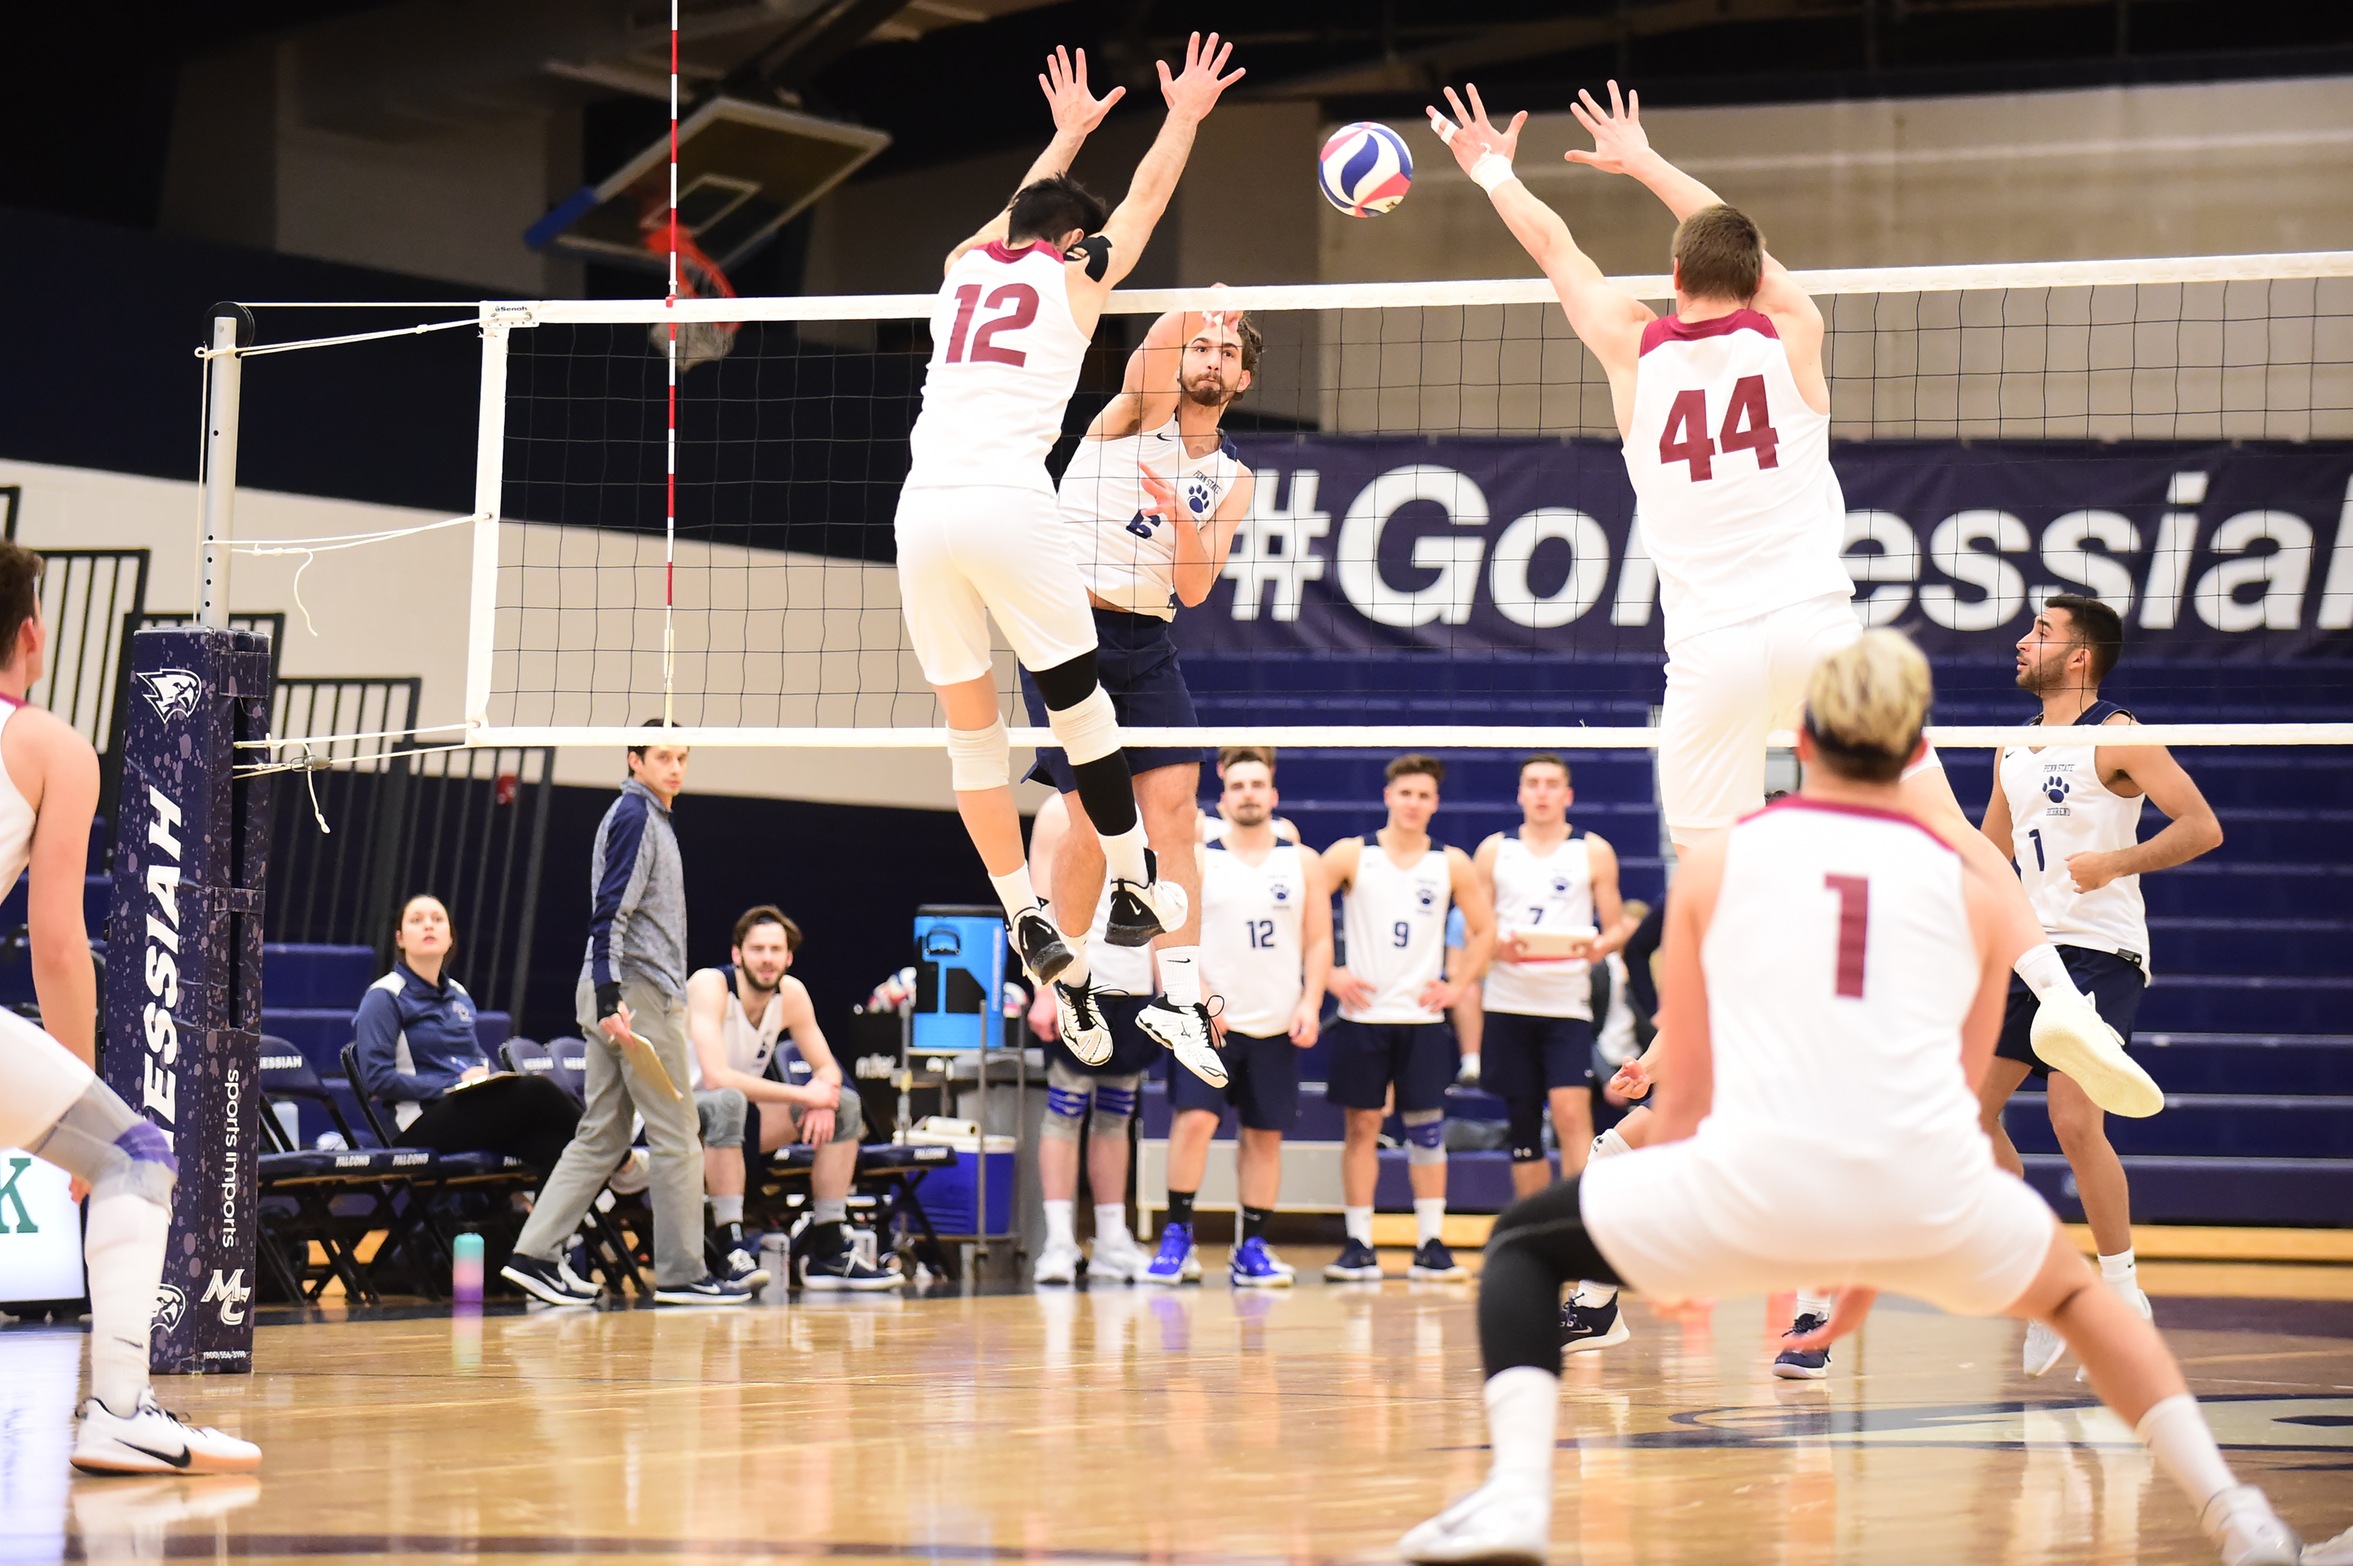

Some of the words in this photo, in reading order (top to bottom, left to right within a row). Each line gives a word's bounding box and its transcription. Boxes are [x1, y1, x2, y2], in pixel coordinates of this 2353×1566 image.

[945, 283, 1040, 368] 12
[1659, 374, 1780, 482] 44
[2028, 828, 2045, 872] 1
[1246, 920, 1275, 949] 12
[1394, 921, 1409, 948] 9
[1528, 907, 1543, 925] 7
[1824, 873, 1869, 999] 1
[143, 784, 182, 1153] ESSIAH
[259, 1055, 302, 1070] ESSIAH
[224, 1068, 240, 1148] sports
